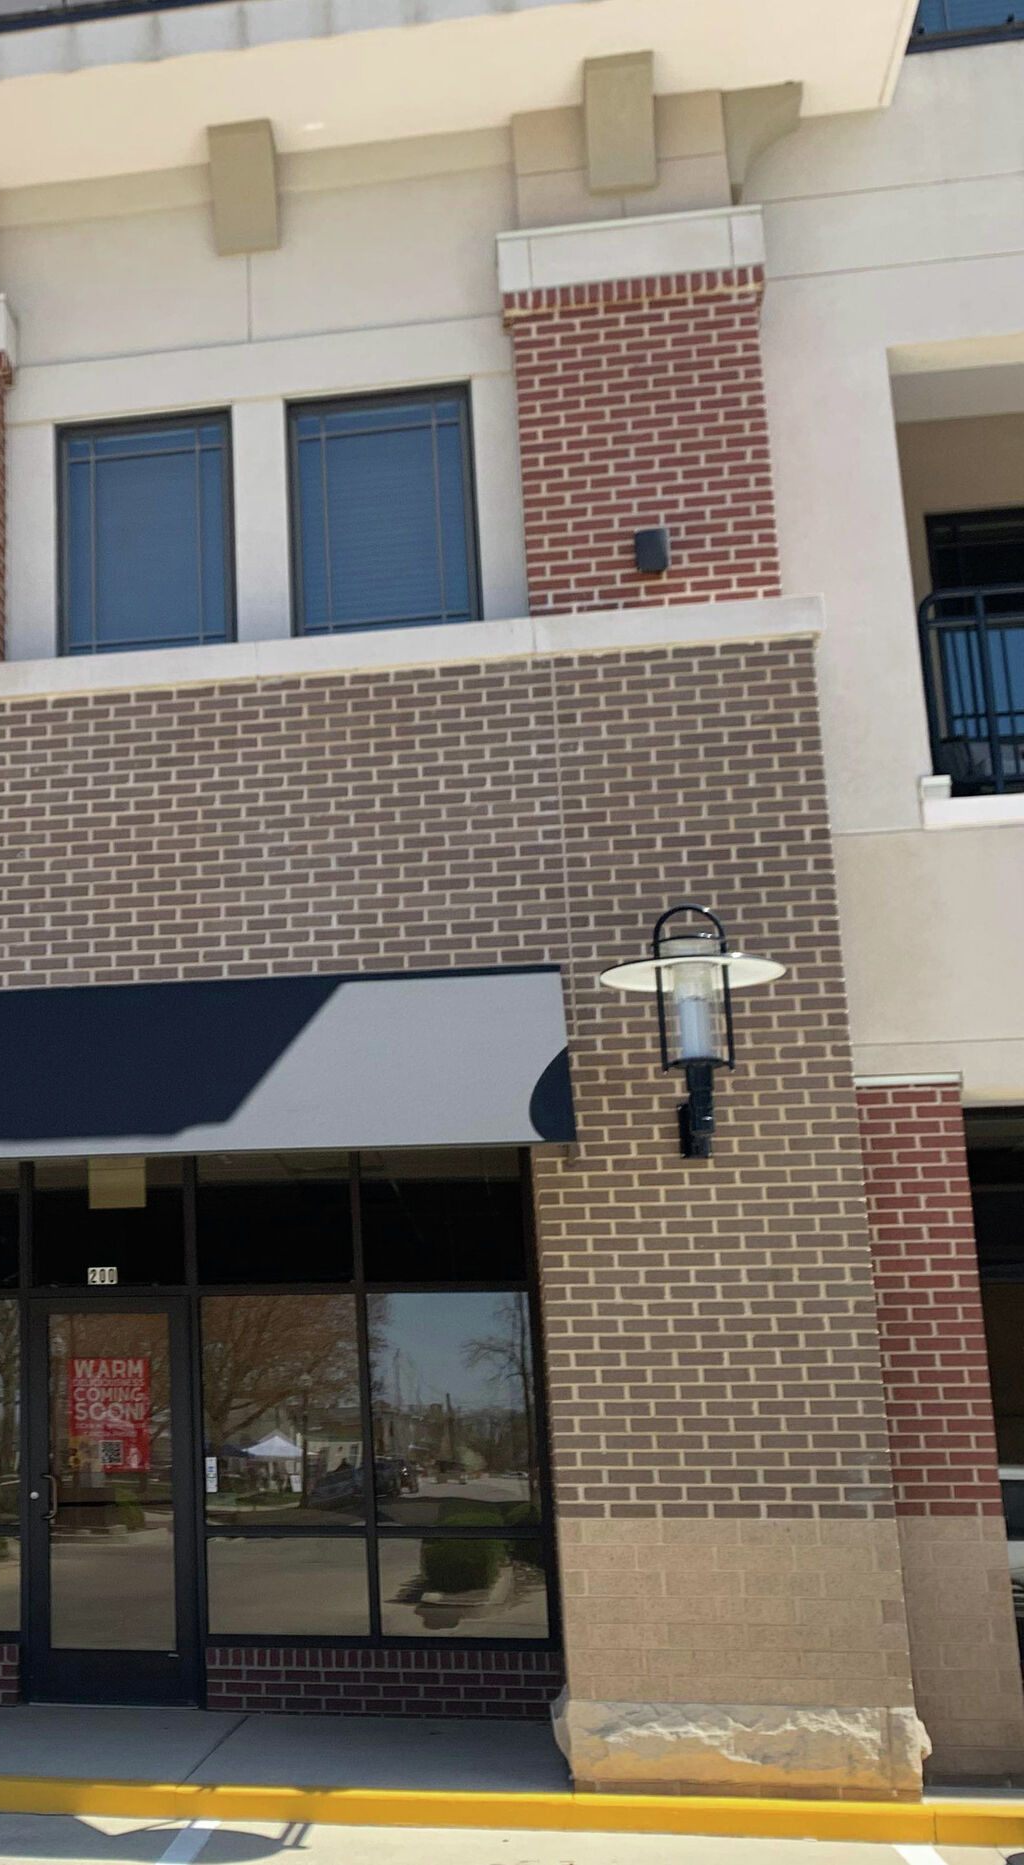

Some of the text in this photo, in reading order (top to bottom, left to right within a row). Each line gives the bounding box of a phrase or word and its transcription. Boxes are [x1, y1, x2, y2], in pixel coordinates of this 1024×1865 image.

[90, 1268, 116, 1283] 200
[73, 1359, 144, 1378] WARM
[73, 1386, 144, 1402] COMING
